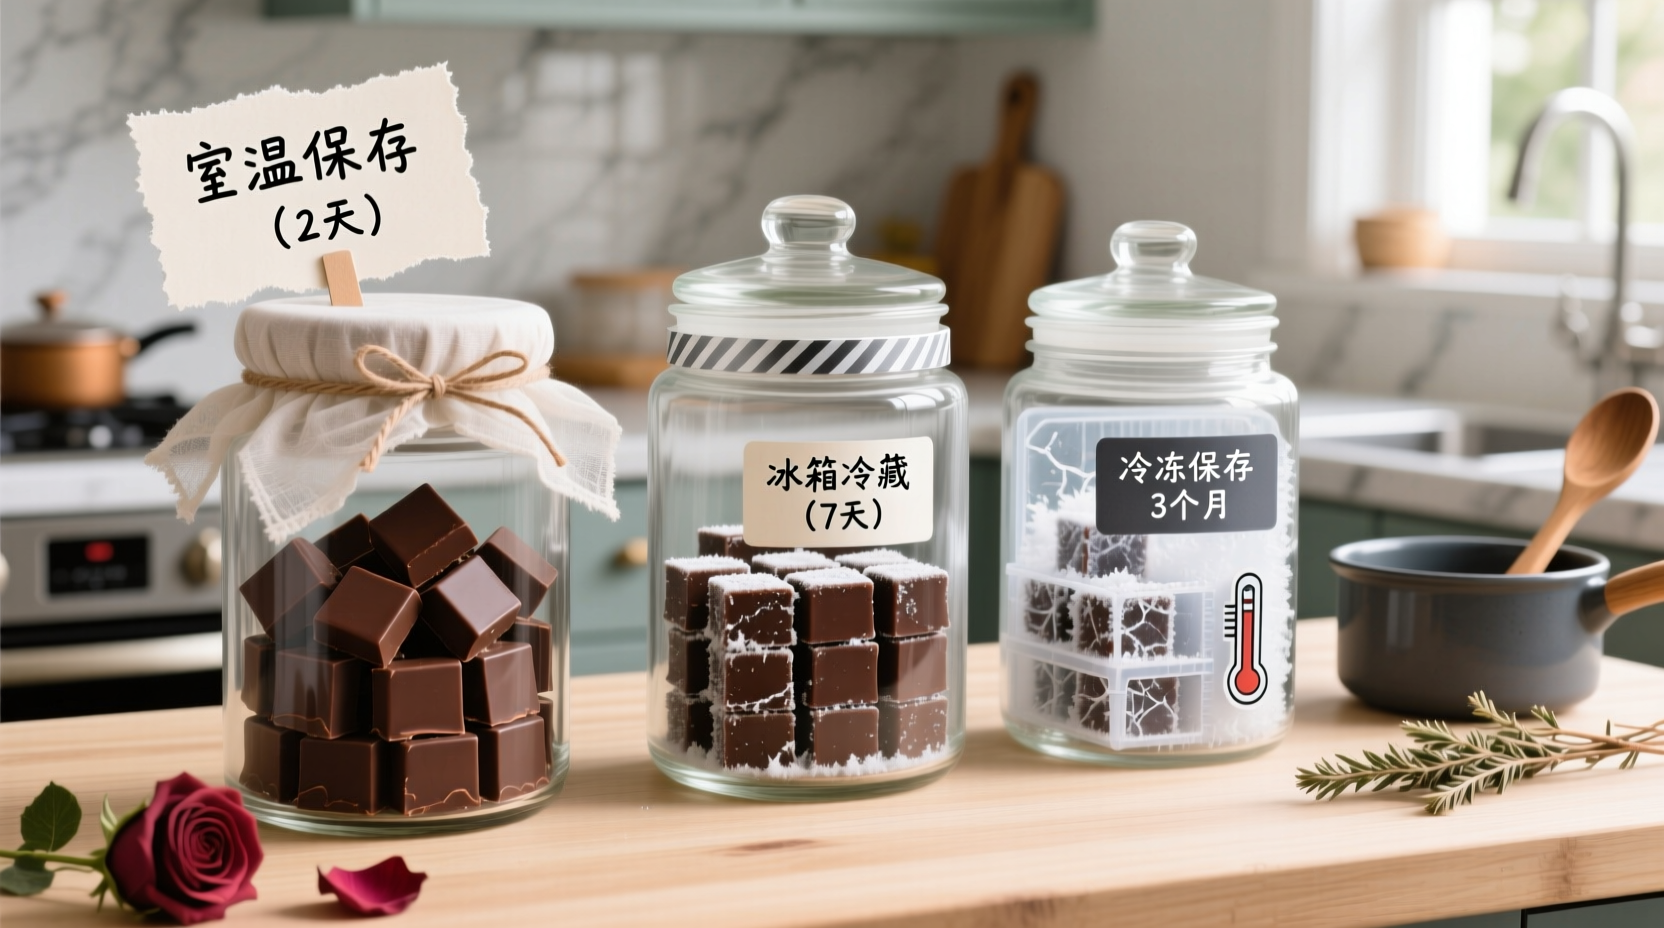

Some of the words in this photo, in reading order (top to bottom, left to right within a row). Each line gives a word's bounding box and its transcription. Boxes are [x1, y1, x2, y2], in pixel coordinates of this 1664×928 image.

[186, 117, 417, 204] 室温保存
[274, 193, 381, 250] (2天)
[766, 453, 910, 493] 冰箱冷藏
[1119, 449, 1254, 484] 冷冻保存
[805, 497, 882, 532] (7天)
[1150, 488, 1226, 521] 3个月
